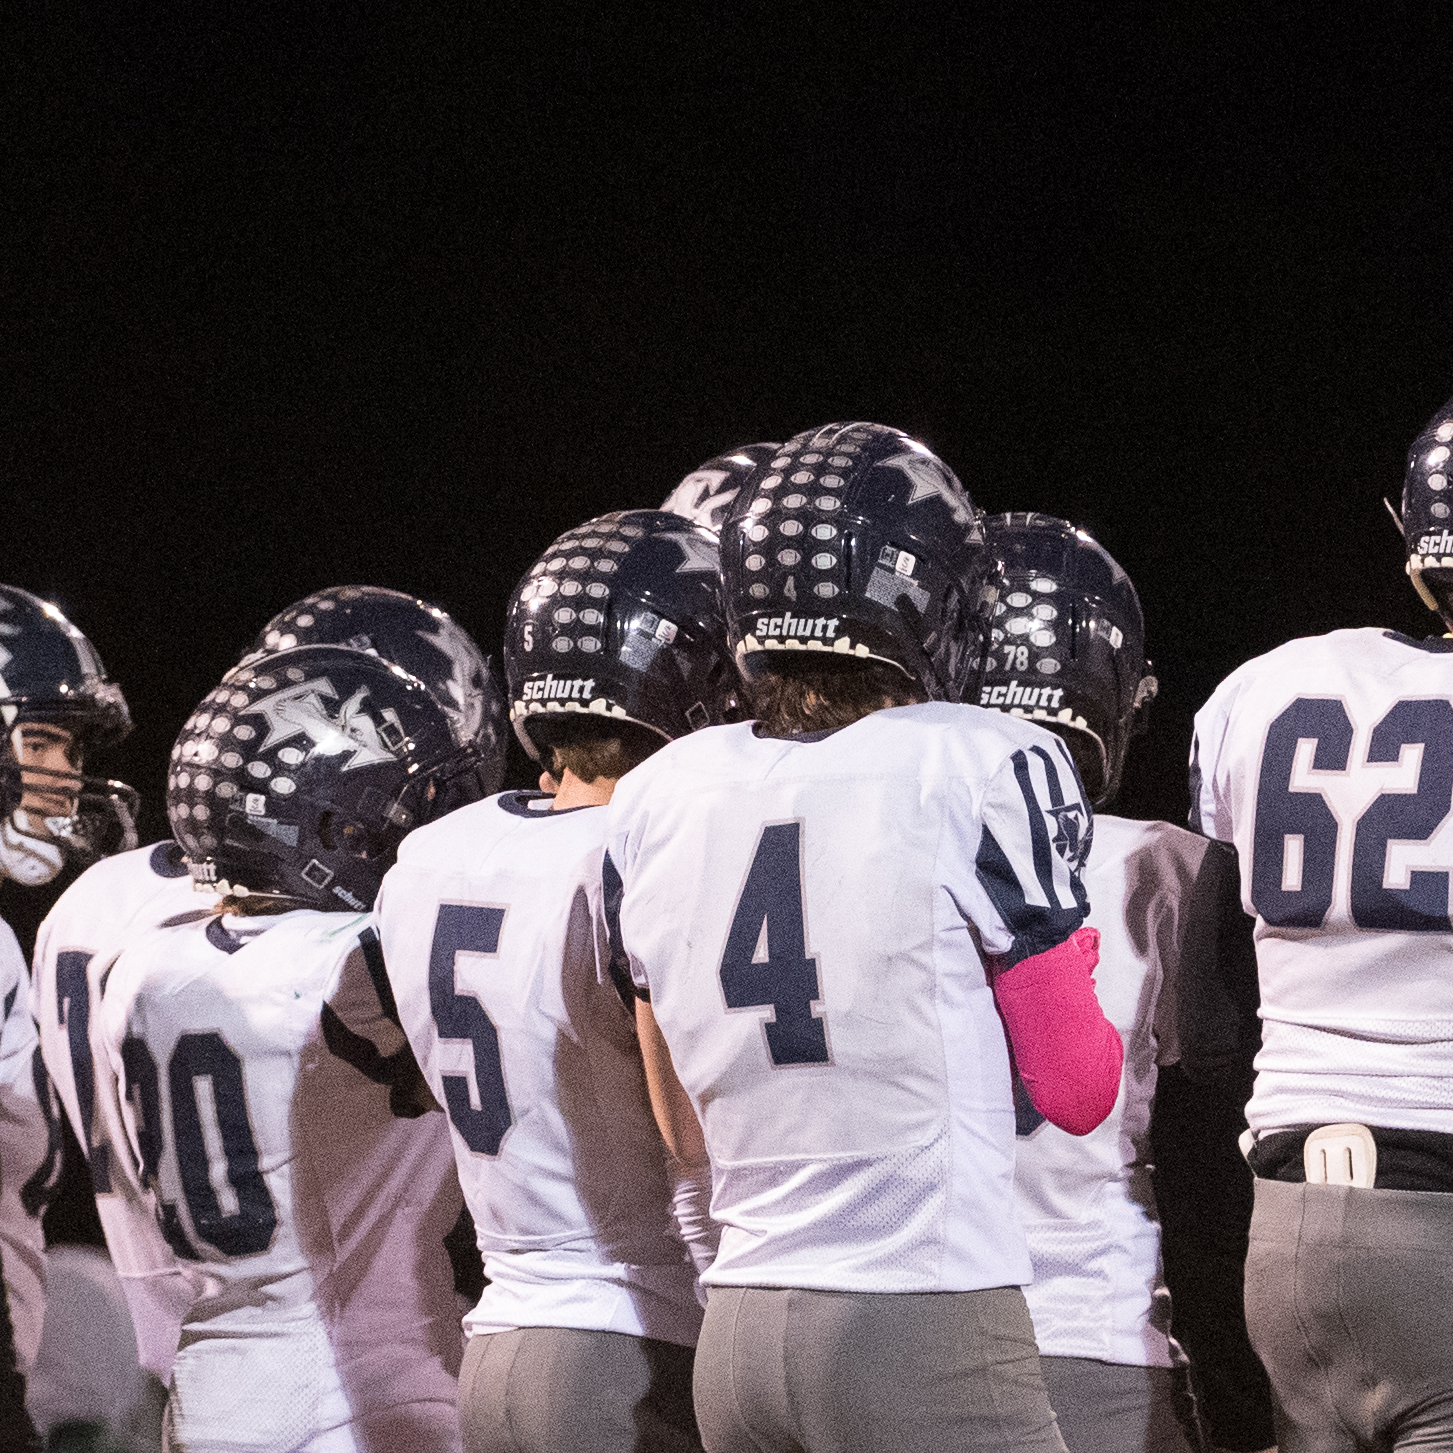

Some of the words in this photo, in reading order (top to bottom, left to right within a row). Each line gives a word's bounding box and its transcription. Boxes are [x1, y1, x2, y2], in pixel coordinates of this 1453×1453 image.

[783, 574, 797, 601] 4
[522, 624, 534, 652] 5
[755, 611, 840, 638] schutt
[1003, 644, 1029, 672] 78
[522, 673, 596, 701] schutt
[979, 680, 1064, 709] schutt
[715, 816, 836, 1070] 4
[428, 898, 515, 1161] 5
